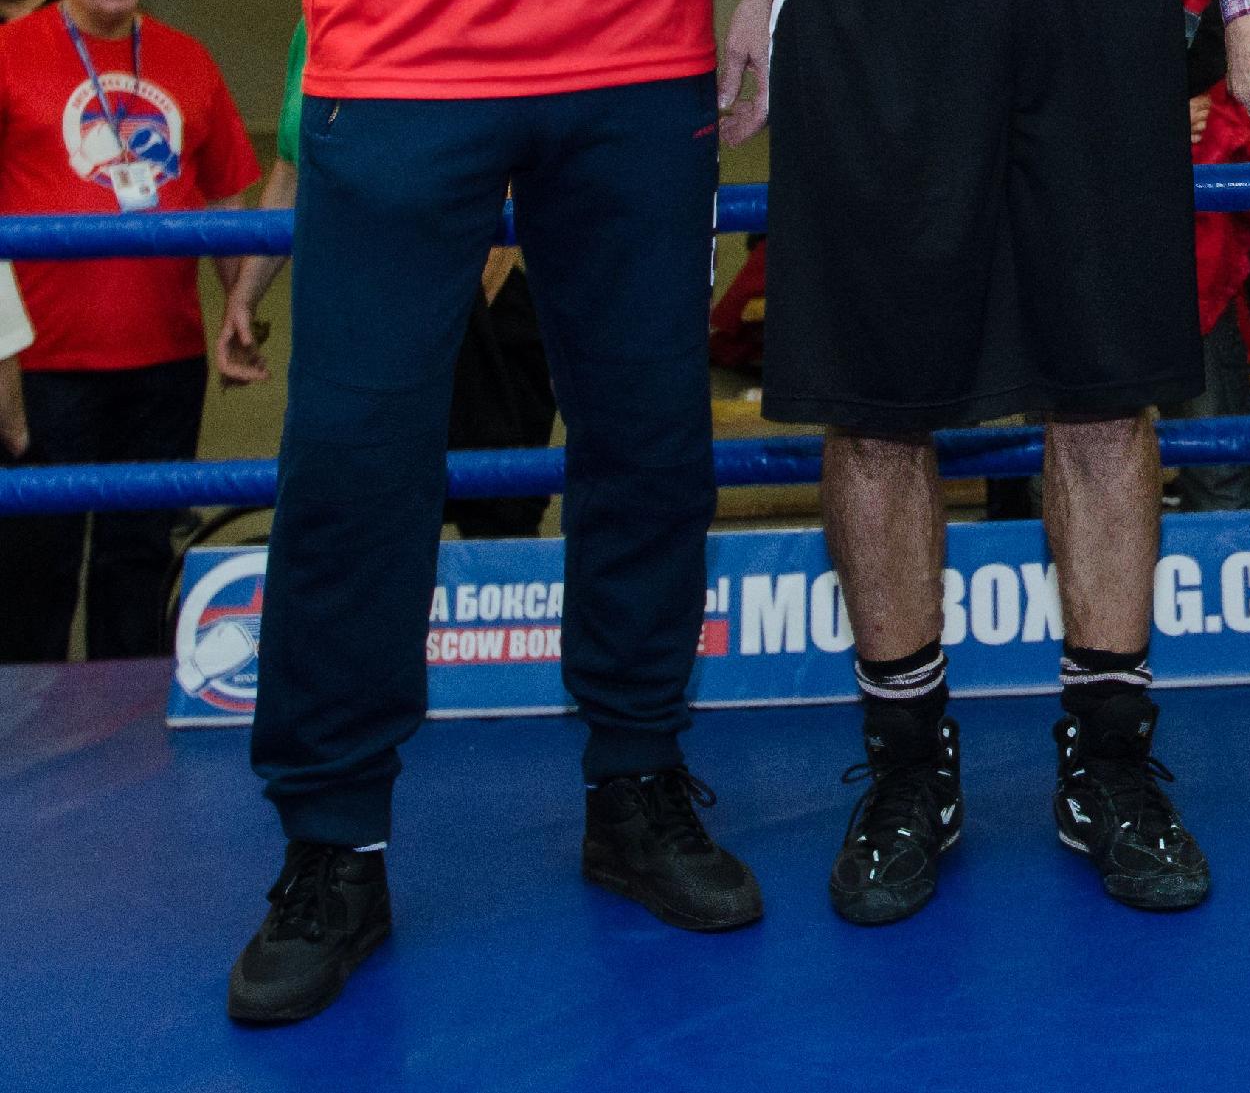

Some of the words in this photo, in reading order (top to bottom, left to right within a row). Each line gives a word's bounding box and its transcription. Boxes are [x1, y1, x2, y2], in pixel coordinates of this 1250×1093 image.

[456, 582, 565, 622] БОКСА
[426, 629, 505, 661] SCOW
[508, 629, 562, 659] BOX
